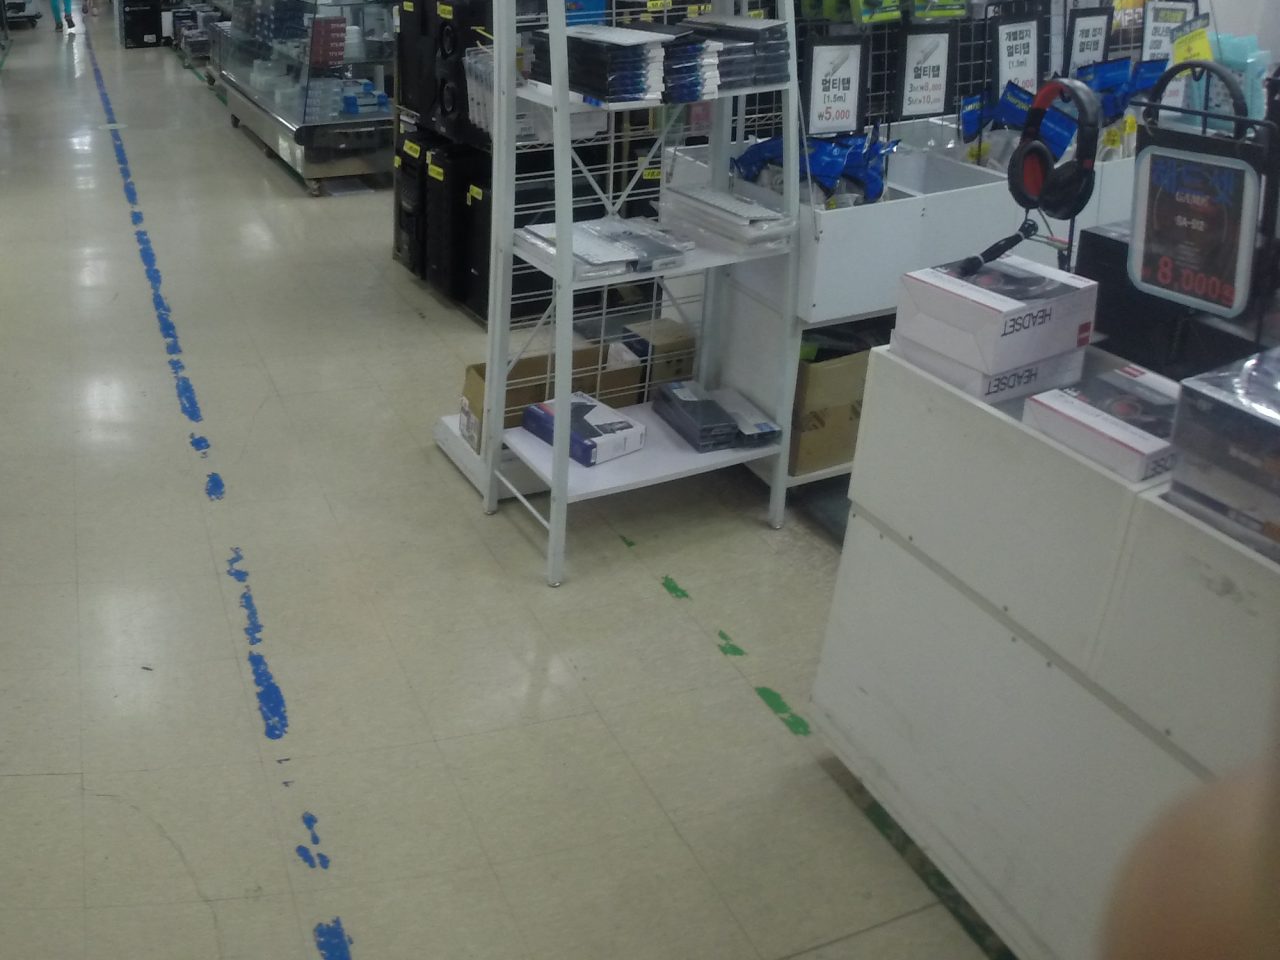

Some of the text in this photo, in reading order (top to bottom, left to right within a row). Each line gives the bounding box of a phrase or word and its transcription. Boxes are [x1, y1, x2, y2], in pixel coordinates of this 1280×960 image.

[821, 77, 851, 93] 멀티탭
[1000, 305, 1052, 338] HEADSET
[985, 366, 1038, 396] HEADSET
